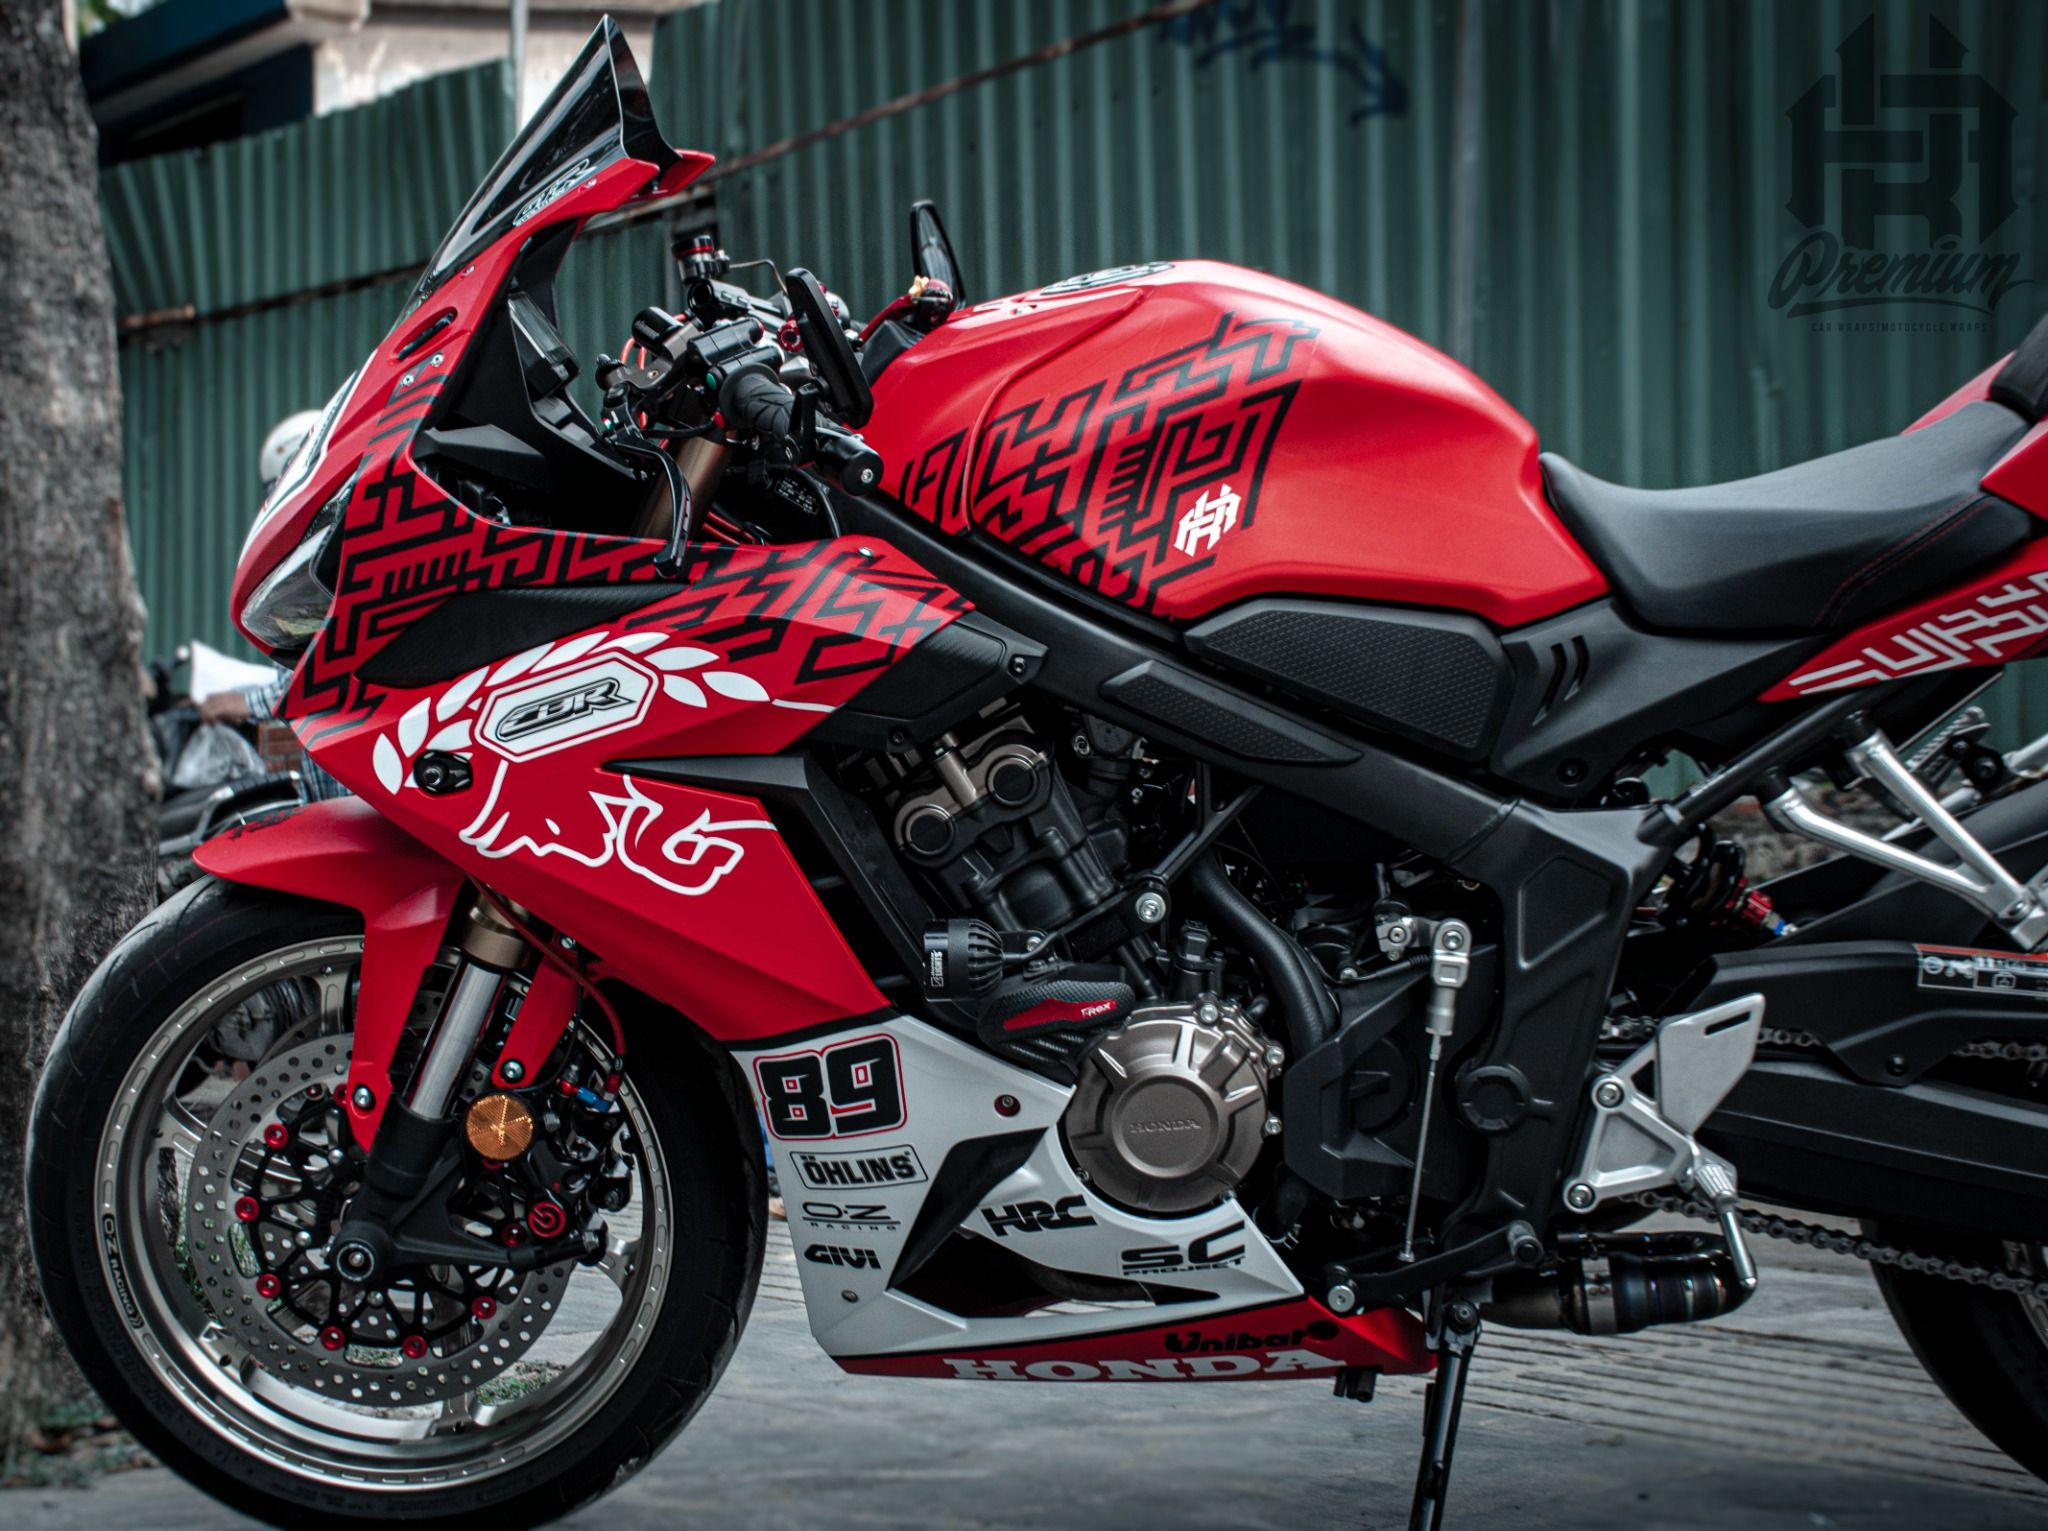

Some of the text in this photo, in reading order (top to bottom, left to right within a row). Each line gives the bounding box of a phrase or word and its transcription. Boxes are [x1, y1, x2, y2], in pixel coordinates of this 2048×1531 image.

[757, 1038, 903, 1138] 89
[1129, 1119, 1201, 1134] HONDA
[800, 1154, 916, 1185] ÖHLINS
[810, 1222, 897, 1231] RACING
[981, 1194, 1098, 1237] HRC
[804, 1244, 882, 1270] GIVI
[1121, 1220, 1245, 1270] SC
[110, 1258, 136, 1315] RACING
[943, 1348, 1347, 1381] HONDA
